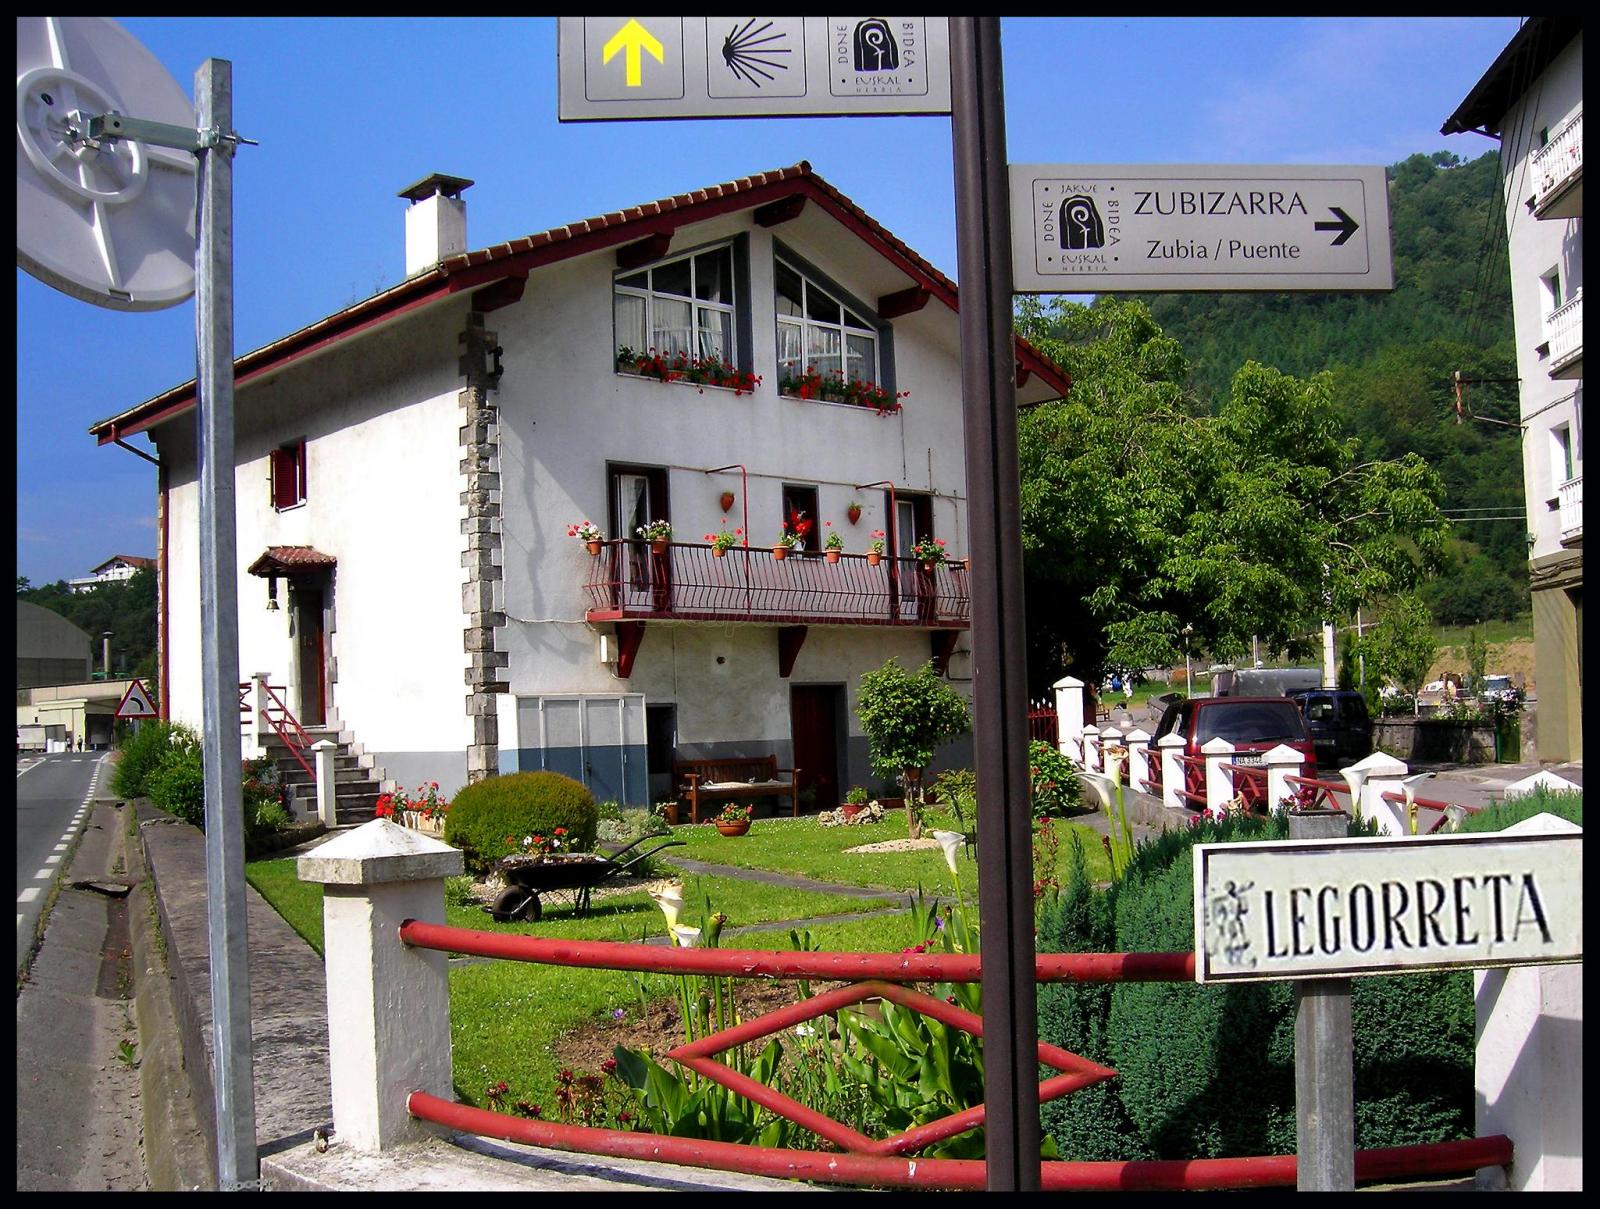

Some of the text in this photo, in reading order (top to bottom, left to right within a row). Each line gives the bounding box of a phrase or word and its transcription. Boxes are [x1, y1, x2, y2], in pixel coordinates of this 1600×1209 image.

[836, 25, 849, 64] DONE
[902, 22, 915, 68] BIDEA
[855, 76, 901, 86] EUSKAL
[1042, 202, 1055, 242] DONE
[1133, 191, 1308, 215] ZUBIZARRA
[1107, 200, 1121, 246] BIDEA
[1061, 254, 1108, 264] EUSKAL
[1146, 239, 1301, 261] Zubia / Puente
[1263, 871, 1554, 960] LEGORRETA
